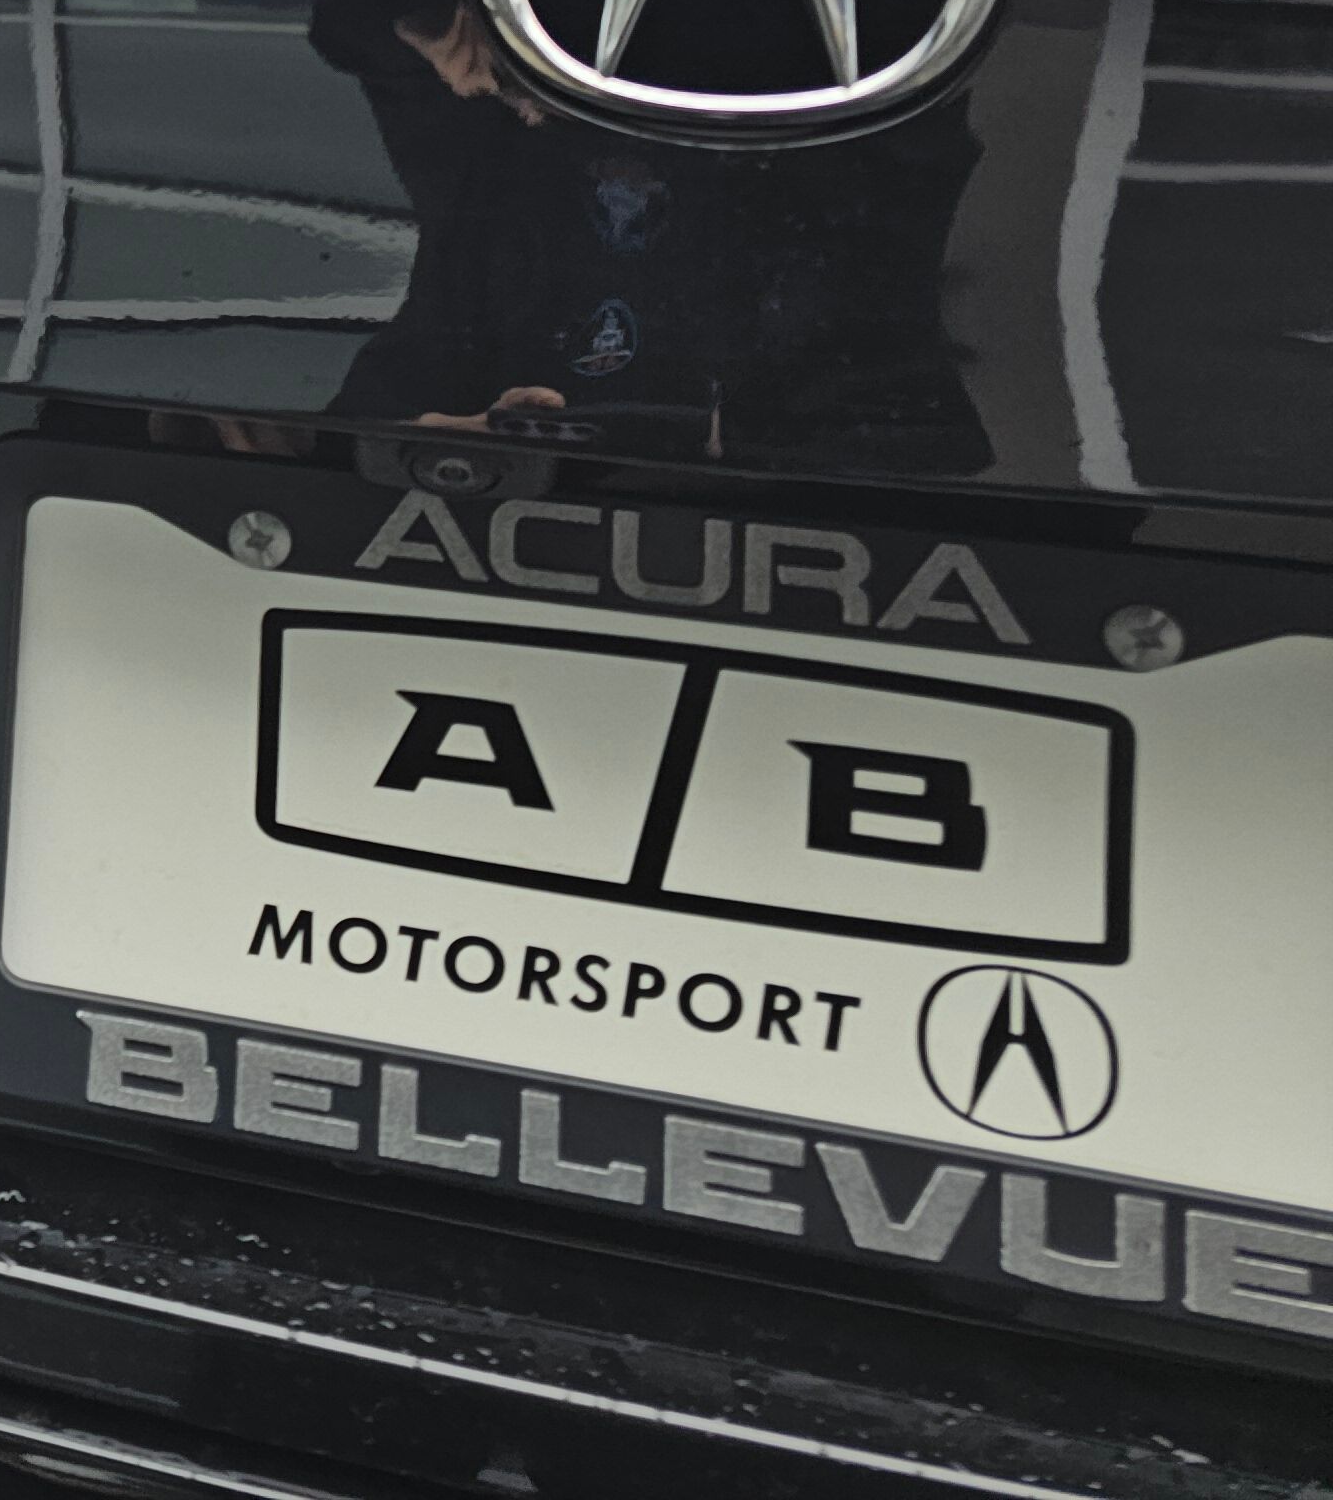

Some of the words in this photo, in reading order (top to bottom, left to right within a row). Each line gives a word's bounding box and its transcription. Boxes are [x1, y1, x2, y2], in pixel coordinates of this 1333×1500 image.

[355, 489, 1031, 646] ACURA
[373, 688, 557, 813] A
[786, 738, 987, 872] B
[247, 903, 863, 1053] MOTORSPORT
[76, 1009, 1333, 1340] BELLEVUE
